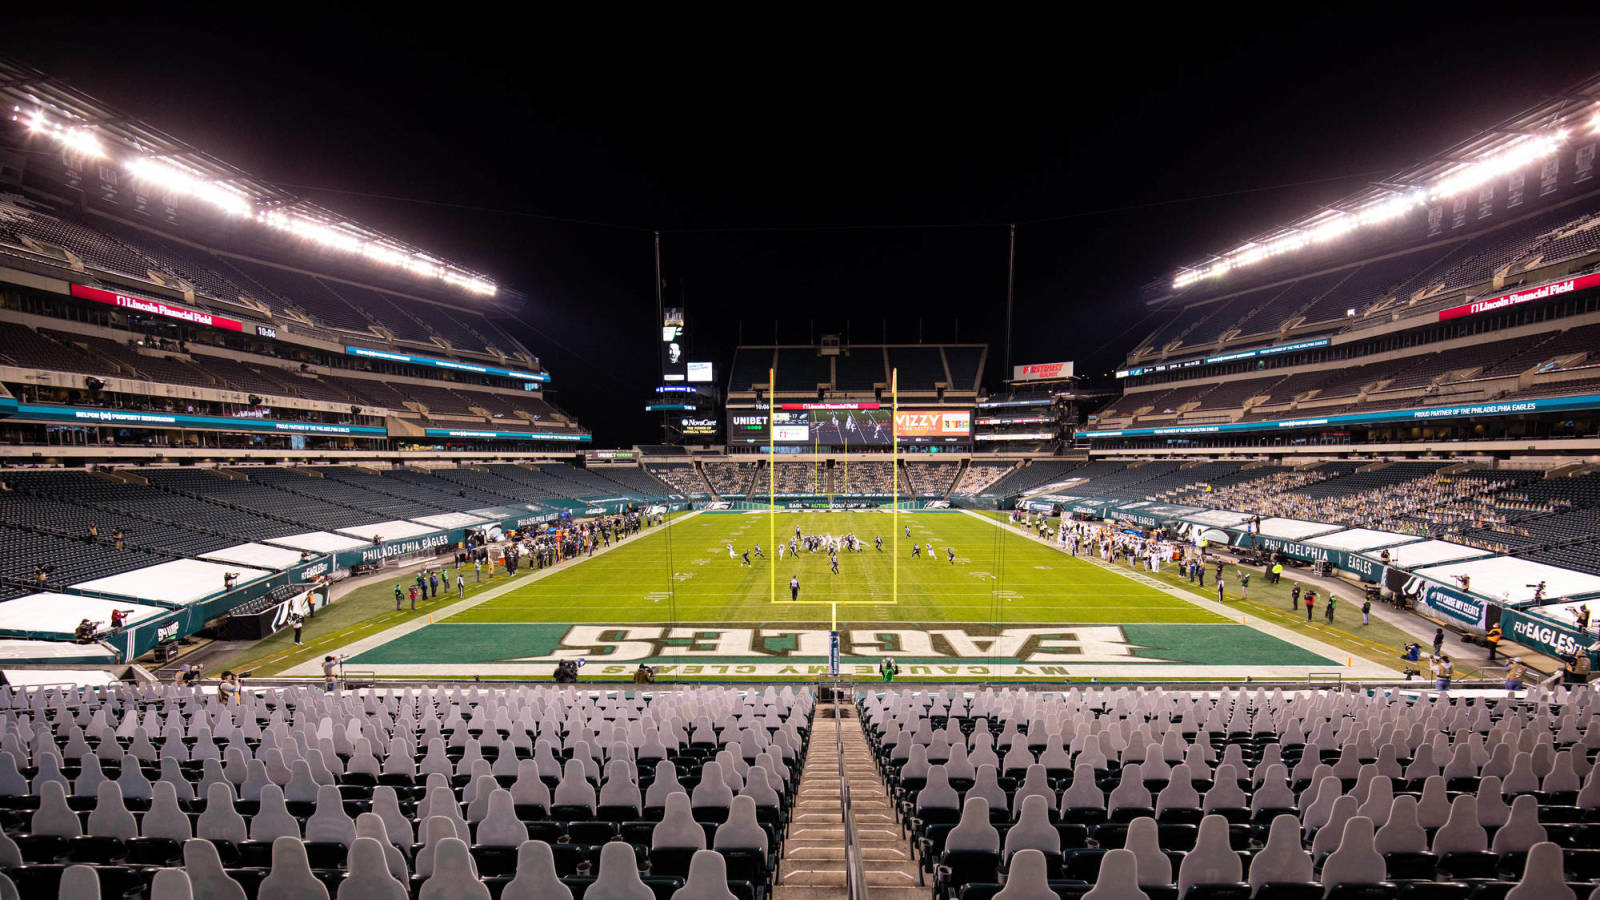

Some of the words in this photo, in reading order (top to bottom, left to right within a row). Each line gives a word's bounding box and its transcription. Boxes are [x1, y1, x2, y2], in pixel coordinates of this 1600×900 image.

[1480, 298, 1509, 312] Lincoln
[1509, 286, 1549, 304] Financial
[1549, 280, 1575, 295] Field
[126, 298, 158, 315] Lincoln
[158, 304, 194, 322] Financial
[193, 312, 212, 326] Field
[258, 326, 276, 338] 10:06
[1430, 409, 1453, 417] PARTNER
[1460, 407, 1471, 415] THE
[1471, 404, 1511, 414] PHILADELPHIA
[1511, 402, 1536, 411] EAGLES
[733, 416, 769, 426] UNIBET
[896, 414, 940, 426] VIZZY
[362, 542, 421, 562] PHILADELPHIA
[422, 535, 449, 549] EAGLES
[1264, 539, 1329, 561] PHILADELPHIA
[1348, 555, 1373, 576] EAGLES
[1443, 594, 1457, 609] CAUSE
[1463, 602, 1480, 617] CLEATS
[502, 622, 1178, 663] EAGLES
[602, 664, 757, 675] CLEAS
[777, 665, 830, 675] MY
[854, 665, 992, 675] CAUE
[1016, 665, 1070, 676] MY
